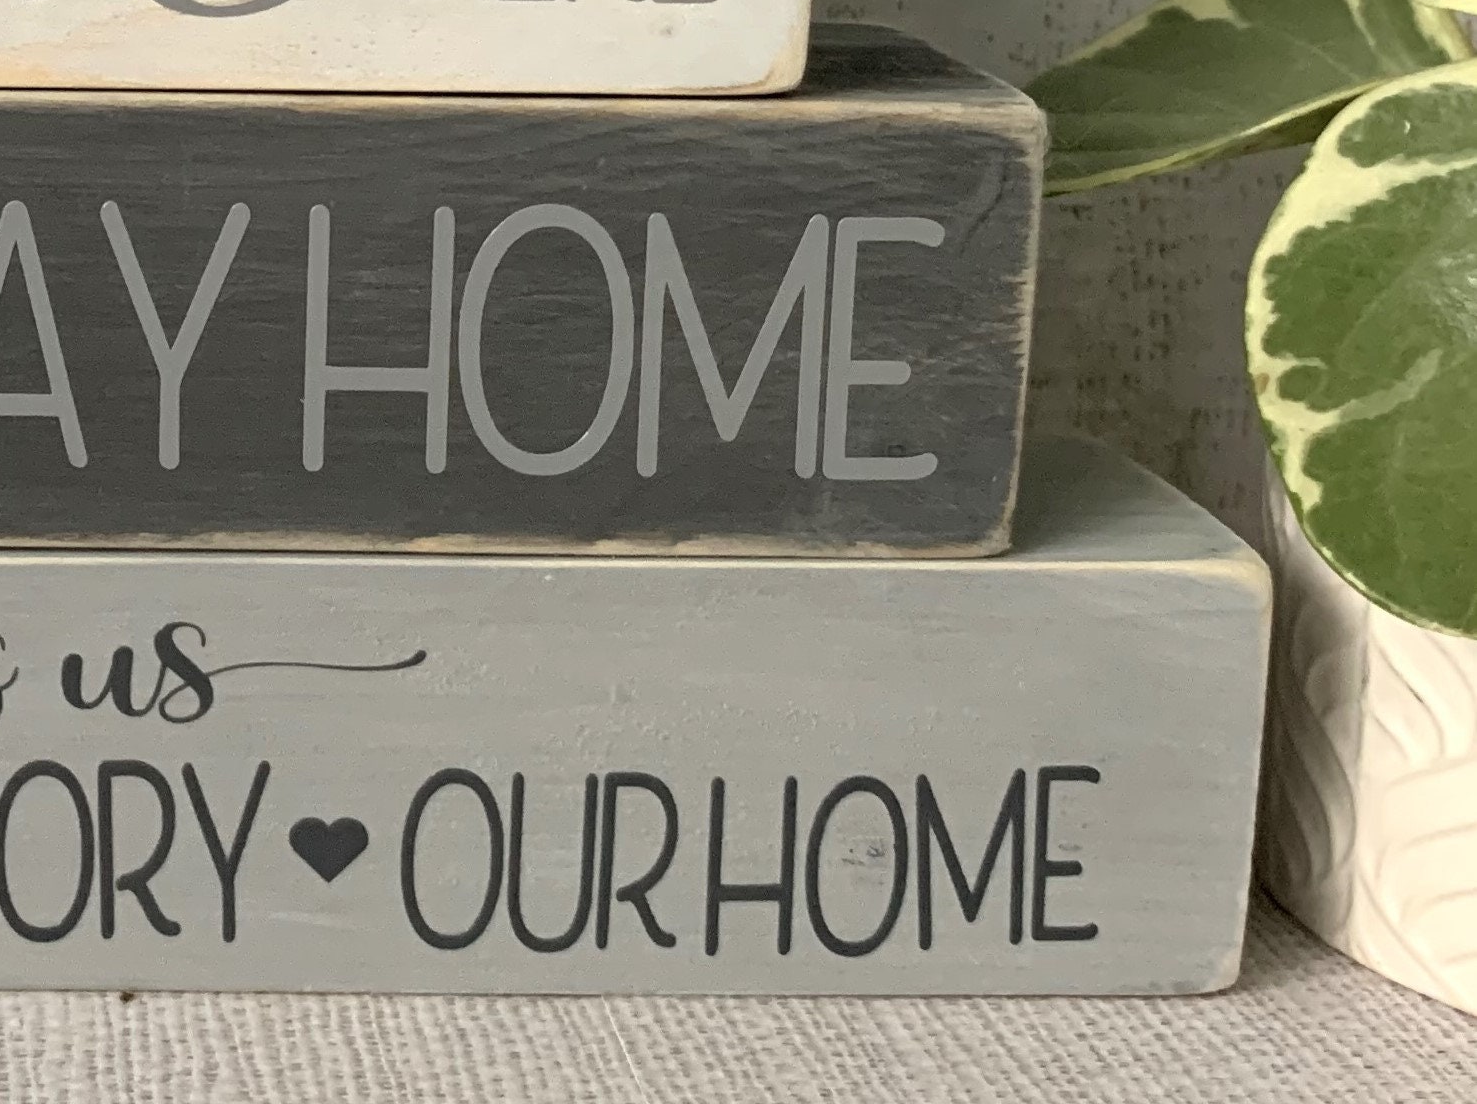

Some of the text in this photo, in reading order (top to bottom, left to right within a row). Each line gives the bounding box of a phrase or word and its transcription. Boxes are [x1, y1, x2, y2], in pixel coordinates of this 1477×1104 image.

[301, 203, 946, 481] HOME
[400, 768, 679, 954] OUR
[705, 765, 1101, 958] HOME
